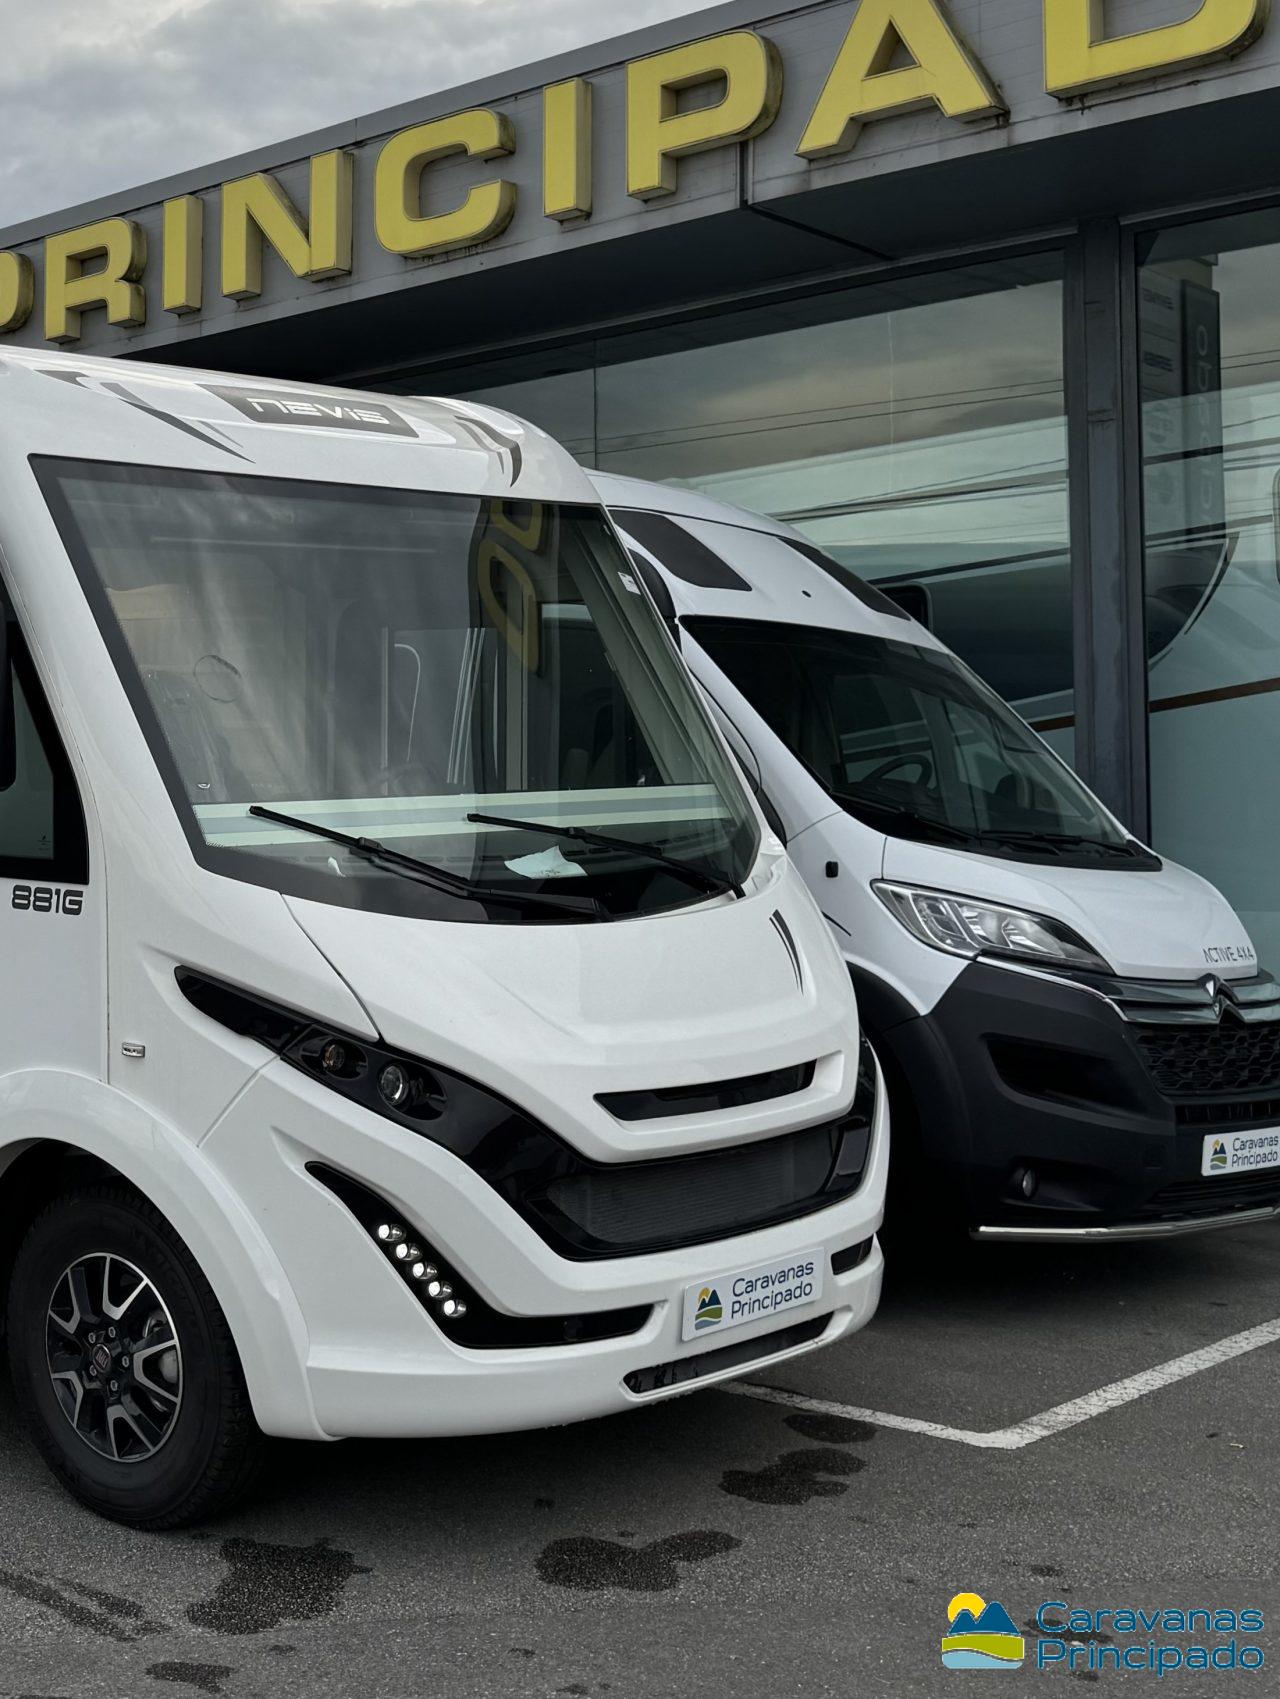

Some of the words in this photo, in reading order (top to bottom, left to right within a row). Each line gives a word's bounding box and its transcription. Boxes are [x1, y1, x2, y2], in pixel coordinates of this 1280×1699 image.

[11, 884, 84, 916] 881G
[1203, 946, 1238, 963] ACTIVE
[1233, 1135, 1279, 1152] Caravanas
[1232, 1150, 1278, 1168] Principado
[732, 1261, 815, 1297] Caravanas
[731, 1281, 813, 1319] Principado
